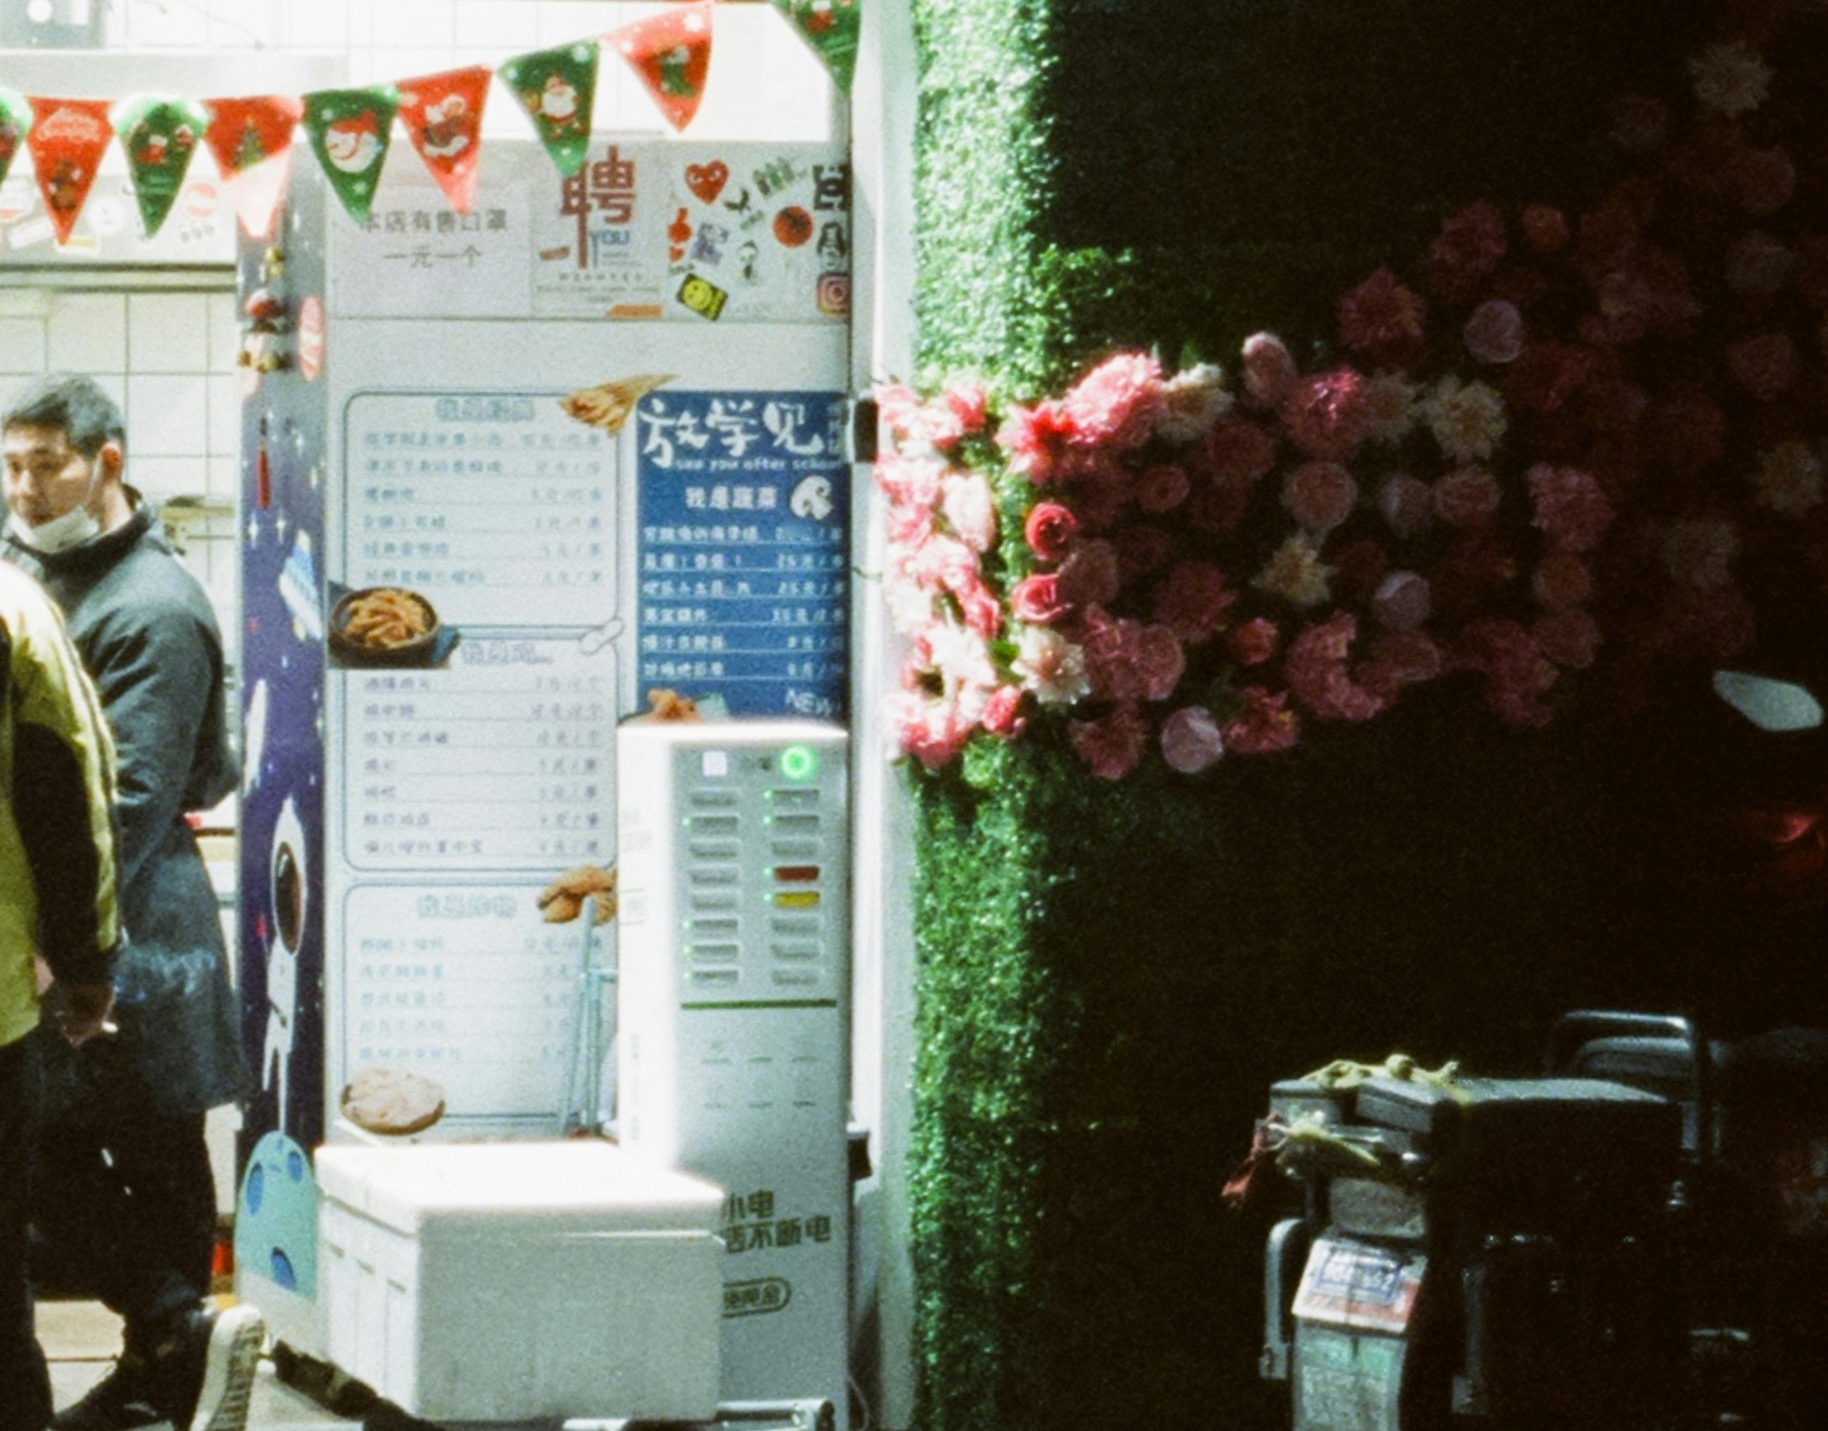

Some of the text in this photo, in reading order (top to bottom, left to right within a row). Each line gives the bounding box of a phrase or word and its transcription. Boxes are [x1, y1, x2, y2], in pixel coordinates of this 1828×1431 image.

[363, 207, 509, 235] 本店有售口罩
[559, 144, 637, 269] 聘
[383, 245, 484, 270] 一元一个
[638, 397, 825, 469] 放学见
[721, 1188, 775, 1221] 小电
